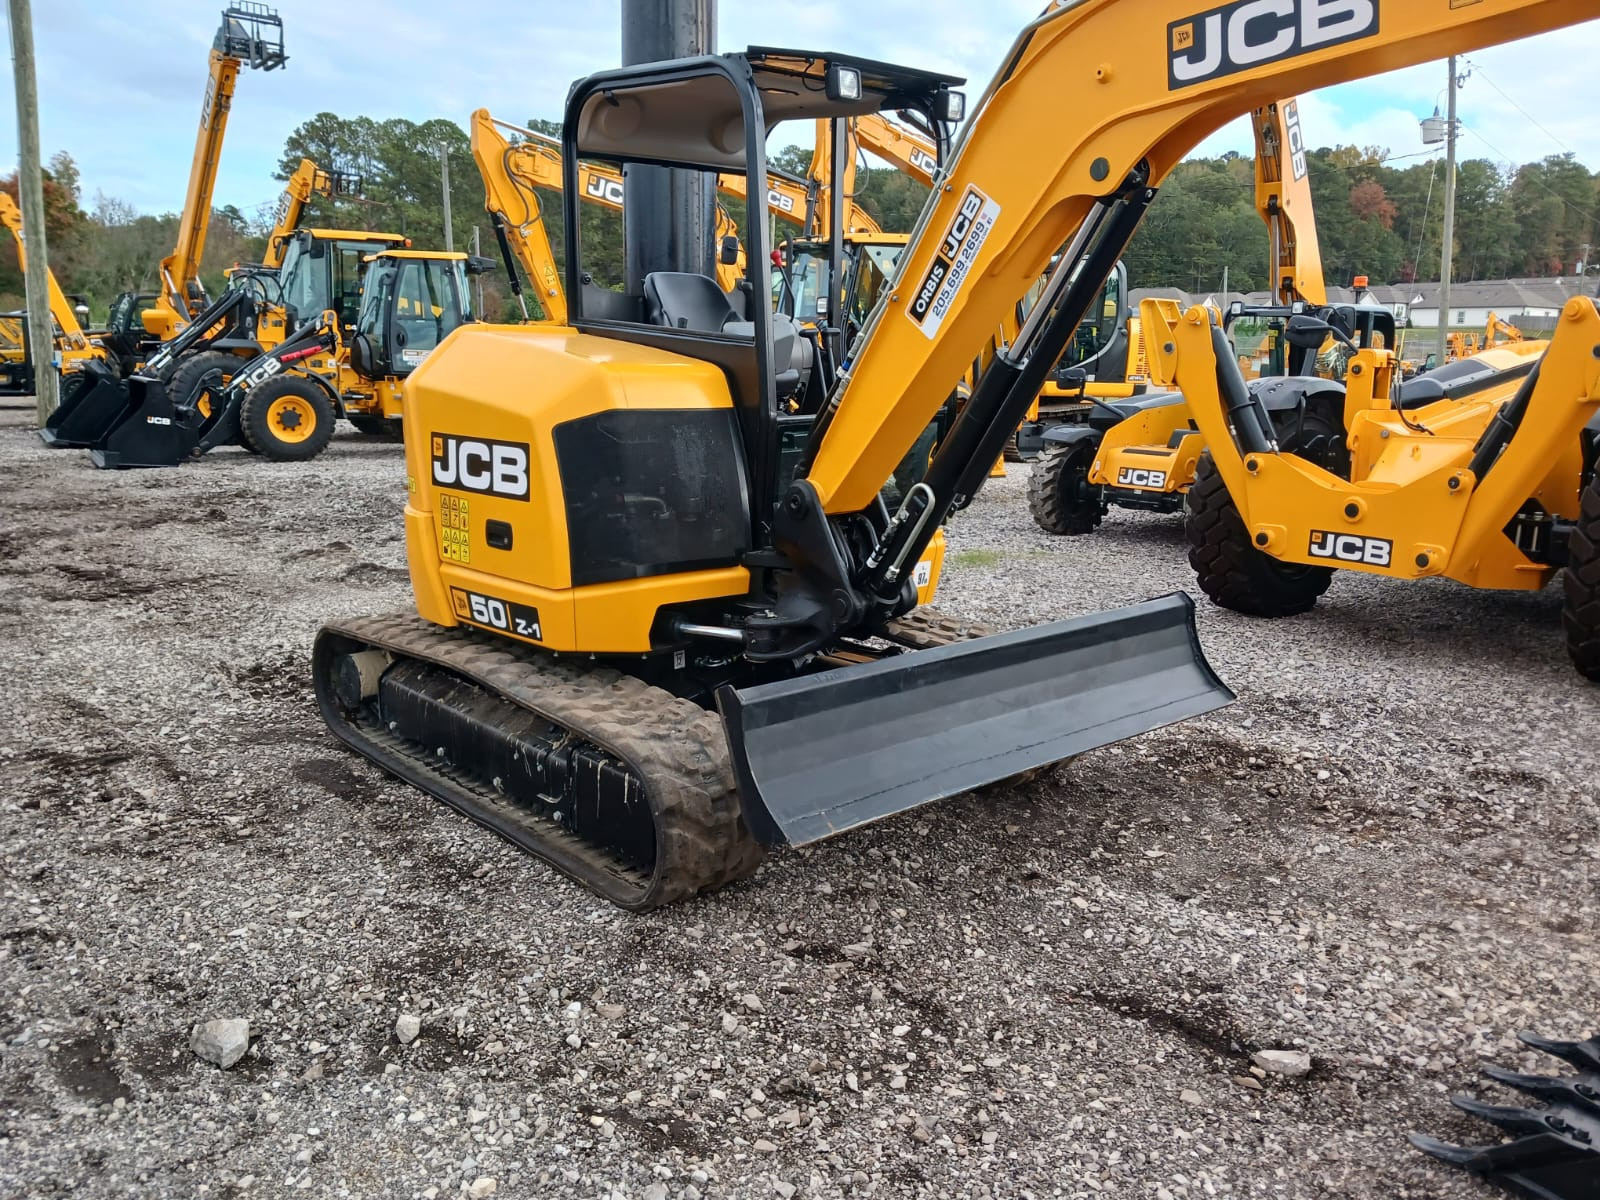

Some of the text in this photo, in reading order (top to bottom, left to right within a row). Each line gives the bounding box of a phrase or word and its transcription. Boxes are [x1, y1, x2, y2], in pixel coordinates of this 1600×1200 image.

[1284, 104, 1306, 179] JCB
[911, 151, 936, 174] JC
[588, 179, 624, 203] JC
[768, 190, 793, 211] CB
[916, 193, 982, 312] ORBIS JCB
[932, 222, 985, 316] 205.699.2699
[147, 416, 171, 425] JCB
[433, 439, 528, 496] JCB
[1119, 469, 1165, 487] JCB
[1310, 534, 1390, 565] JCB
[470, 594, 507, 629] 50
